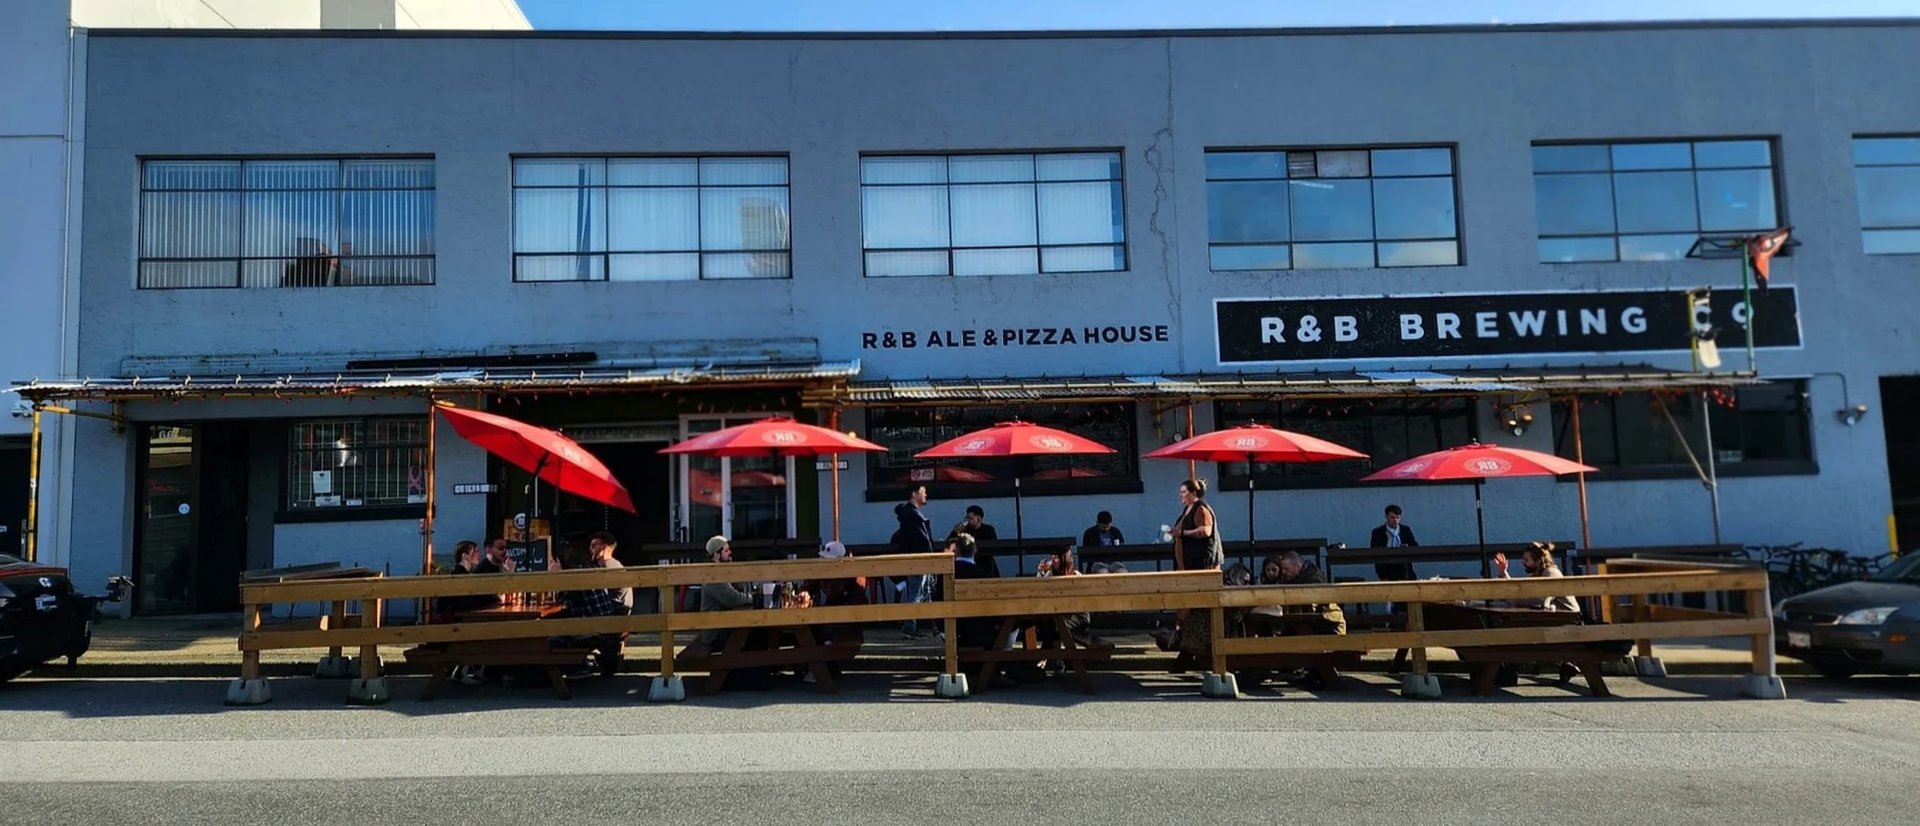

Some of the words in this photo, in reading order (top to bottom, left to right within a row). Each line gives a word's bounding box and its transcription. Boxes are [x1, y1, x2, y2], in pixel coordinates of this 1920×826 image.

[862, 331, 918, 350] R&B
[926, 329, 977, 348] ALE
[1002, 327, 1077, 347] PIZZA
[1083, 325, 1169, 344] HOUSE
[1260, 315, 1359, 343] R&B
[1399, 306, 1647, 340] BREWING
